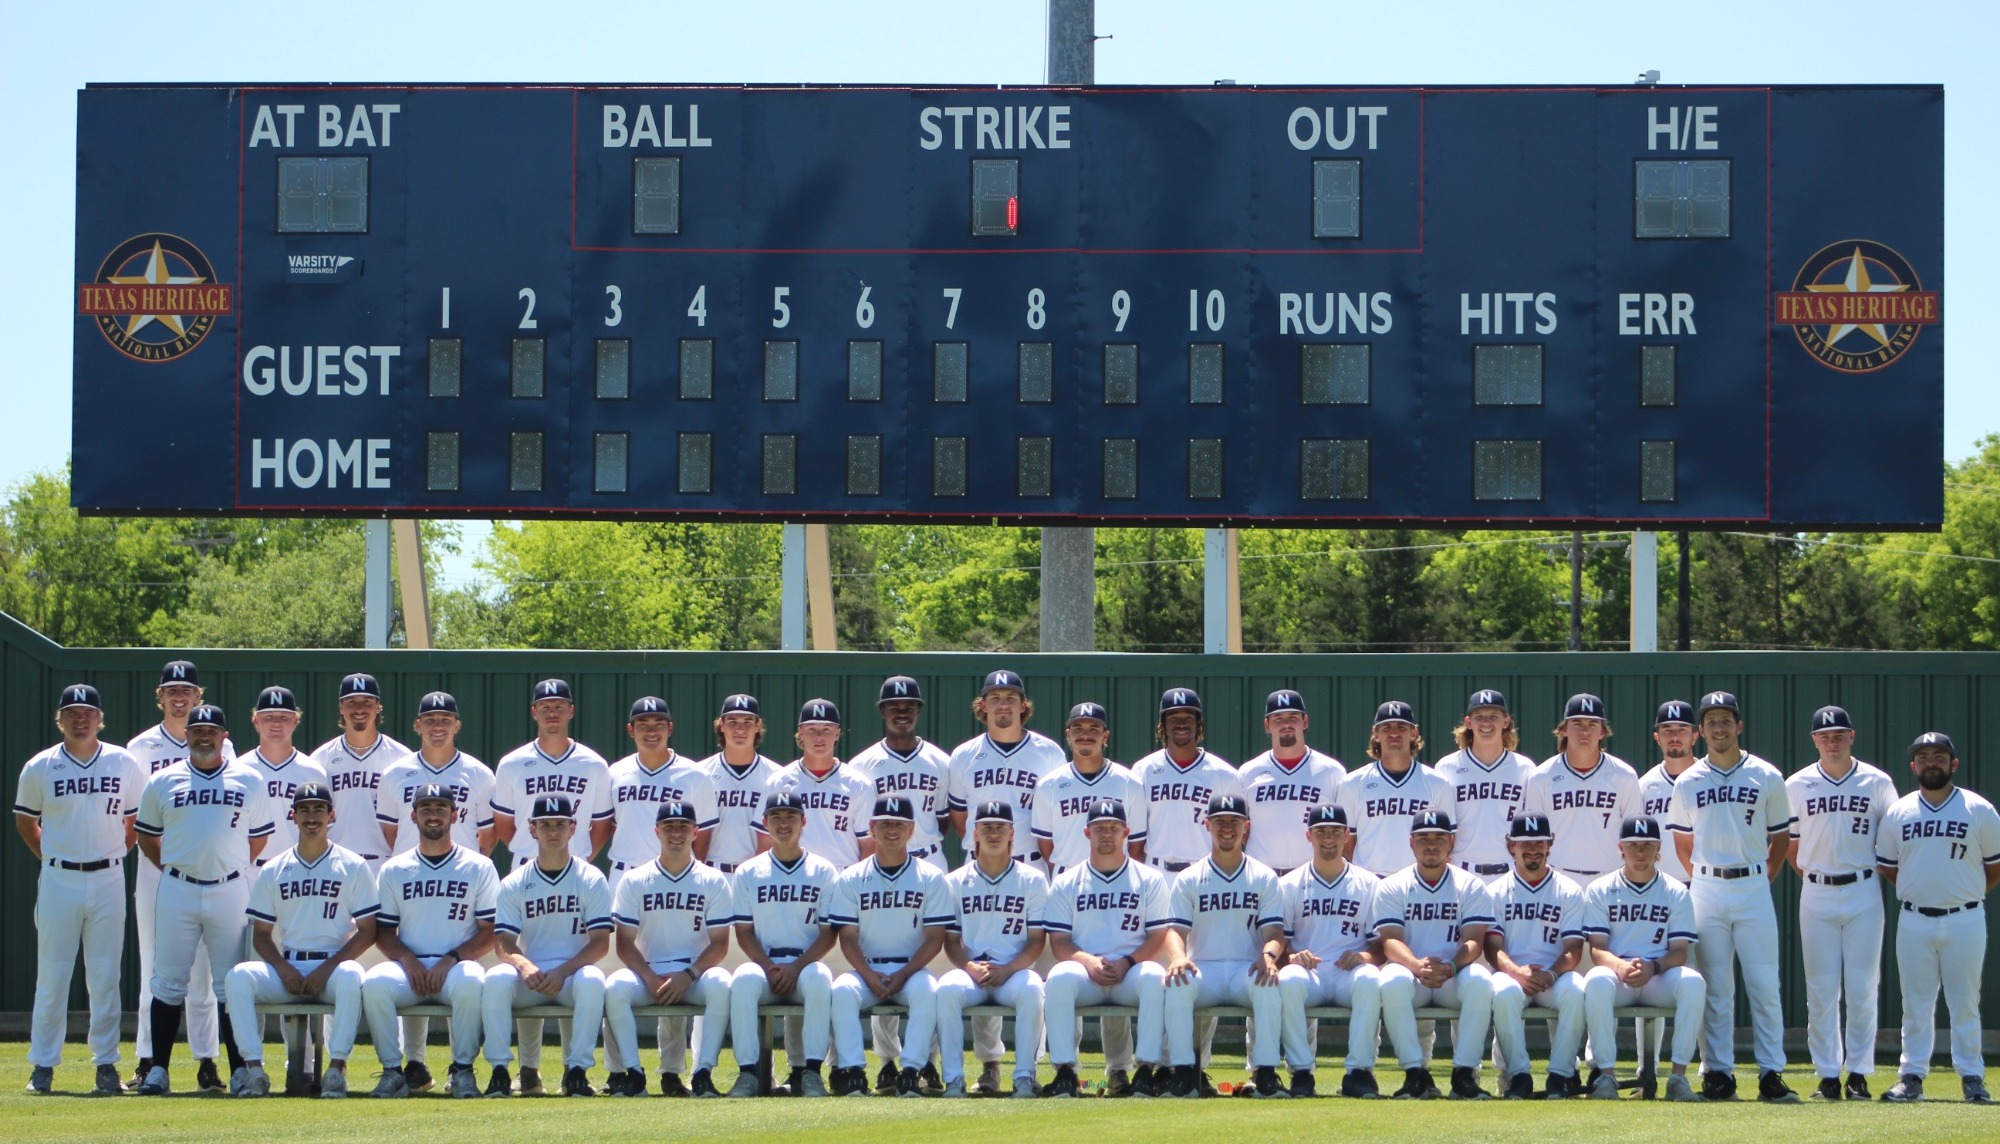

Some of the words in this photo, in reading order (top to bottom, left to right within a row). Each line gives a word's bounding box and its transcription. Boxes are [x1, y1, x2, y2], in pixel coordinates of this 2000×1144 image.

[249, 105, 304, 147] AT
[319, 105, 400, 147] BAT
[604, 105, 712, 147] BALL
[921, 106, 1070, 150] STRIKE
[1288, 107, 1387, 150] OUT
[1648, 106, 1718, 150] H/E
[289, 256, 336, 267] VARSITY
[83, 287, 137, 311] TEXAS
[142, 287, 229, 311] HERITAGE
[443, 288, 449, 328] 1
[519, 288, 537, 328] 2
[605, 285, 622, 326] 3
[688, 286, 706, 326] 4
[773, 287, 790, 328] 5
[856, 287, 874, 328] 6
[1779, 296, 1837, 320] TEXAS
[1842, 296, 1934, 320] HERITAGE
[944, 289, 962, 329] 7
[1027, 288, 1045, 329] 8
[1112, 290, 1130, 331] 9
[1190, 290, 1225, 331] 10
[1280, 292, 1392, 334] RUNS
[1461, 292, 1556, 334] HITS
[1619, 293, 1696, 334] ERR
[105, 322, 171, 359] NATIONAL
[176, 321, 208, 352] BANK
[1804, 333, 1873, 369] NATIONAL
[1879, 332, 1912, 362] BANK
[244, 346, 400, 395] GUEST
[253, 439, 390, 488] HOME
[173, 665, 185, 678] N
[996, 673, 1008, 685] N
[353, 678, 365, 690] N
[545, 682, 557, 694] N
[895, 682, 907, 694] N
[74, 689, 86, 701] N
[271, 692, 283, 705] N
[432, 696, 445, 707] N
[736, 696, 748, 708] N
[1174, 692, 1185, 704] N
[1278, 693, 1290, 705] N
[1480, 692, 1492, 703] N
[1711, 693, 1723, 704] N
[199, 708, 211, 720] N
[645, 699, 656, 711] N
[813, 705, 825, 717] N
[1080, 704, 1092, 715] N
[1389, 704, 1400, 715] N
[1581, 699, 1593, 712] N
[1668, 705, 1680, 718] N
[1822, 712, 1835, 724] N
[1924, 733, 1935, 743] N
[54, 777, 120, 797] EAGLES
[332, 771, 381, 792] EAGLE
[526, 775, 587, 795] EAGLES
[875, 773, 938, 794] EAGLES
[974, 768, 1037, 789] EAGLES
[174, 789, 244, 808] EAGLES
[268, 781, 297, 799] GLE
[304, 784, 317, 797] N
[404, 785, 469, 803] EES
[428, 785, 440, 796] N
[618, 785, 683, 802] EAGLES
[715, 790, 761, 808] AGLE
[778, 792, 790, 806] N
[1151, 783, 1212, 804] EAGLES
[1256, 785, 1320, 803] EAGLES
[1457, 782, 1522, 802] EAGLES
[1697, 786, 1759, 808] EAGLES
[107, 798, 120, 814] 15
[546, 797, 559, 811] N
[670, 803, 682, 815] N
[800, 792, 850, 811] AGLES
[886, 798, 899, 811] N
[987, 802, 999, 814] N
[1101, 802, 1113, 815] N
[1221, 797, 1234, 808] N
[1553, 790, 1616, 810] EAGLES
[1807, 795, 1870, 816] EAGLES
[231, 812, 240, 828] 2
[456, 807, 468, 823] 4
[1322, 807, 1334, 819] N
[1424, 813, 1436, 825] N
[1603, 813, 1610, 828] 7
[1525, 817, 1538, 831] N
[1635, 820, 1648, 833] N
[1852, 817, 1869, 835] 23
[1903, 820, 1968, 841] EAGLES
[1951, 843, 1967, 859] 17
[280, 879, 341, 900] EAGLES
[403, 880, 468, 900] EAGLES
[758, 885, 820, 903] EAGLES
[644, 892, 705, 911] EAGLES
[860, 891, 923, 910] EAGLES
[962, 895, 1024, 914] EAGLES
[1077, 892, 1140, 911] EAGLES
[1199, 892, 1259, 912] EAGLES
[1302, 898, 1360, 917] EAGLES
[323, 902, 338, 919] 10
[448, 903, 468, 920] 35
[1404, 903, 1457, 920] EAGLES
[1505, 902, 1561, 922] EAGLES
[1609, 904, 1670, 923] EAGLES
[694, 916, 702, 931] 5
[1002, 918, 1024, 935] 26
[1121, 914, 1139, 931] 29
[1341, 921, 1359, 937] 24
[1544, 926, 1559, 944] 12
[1652, 928, 1664, 944] 9
